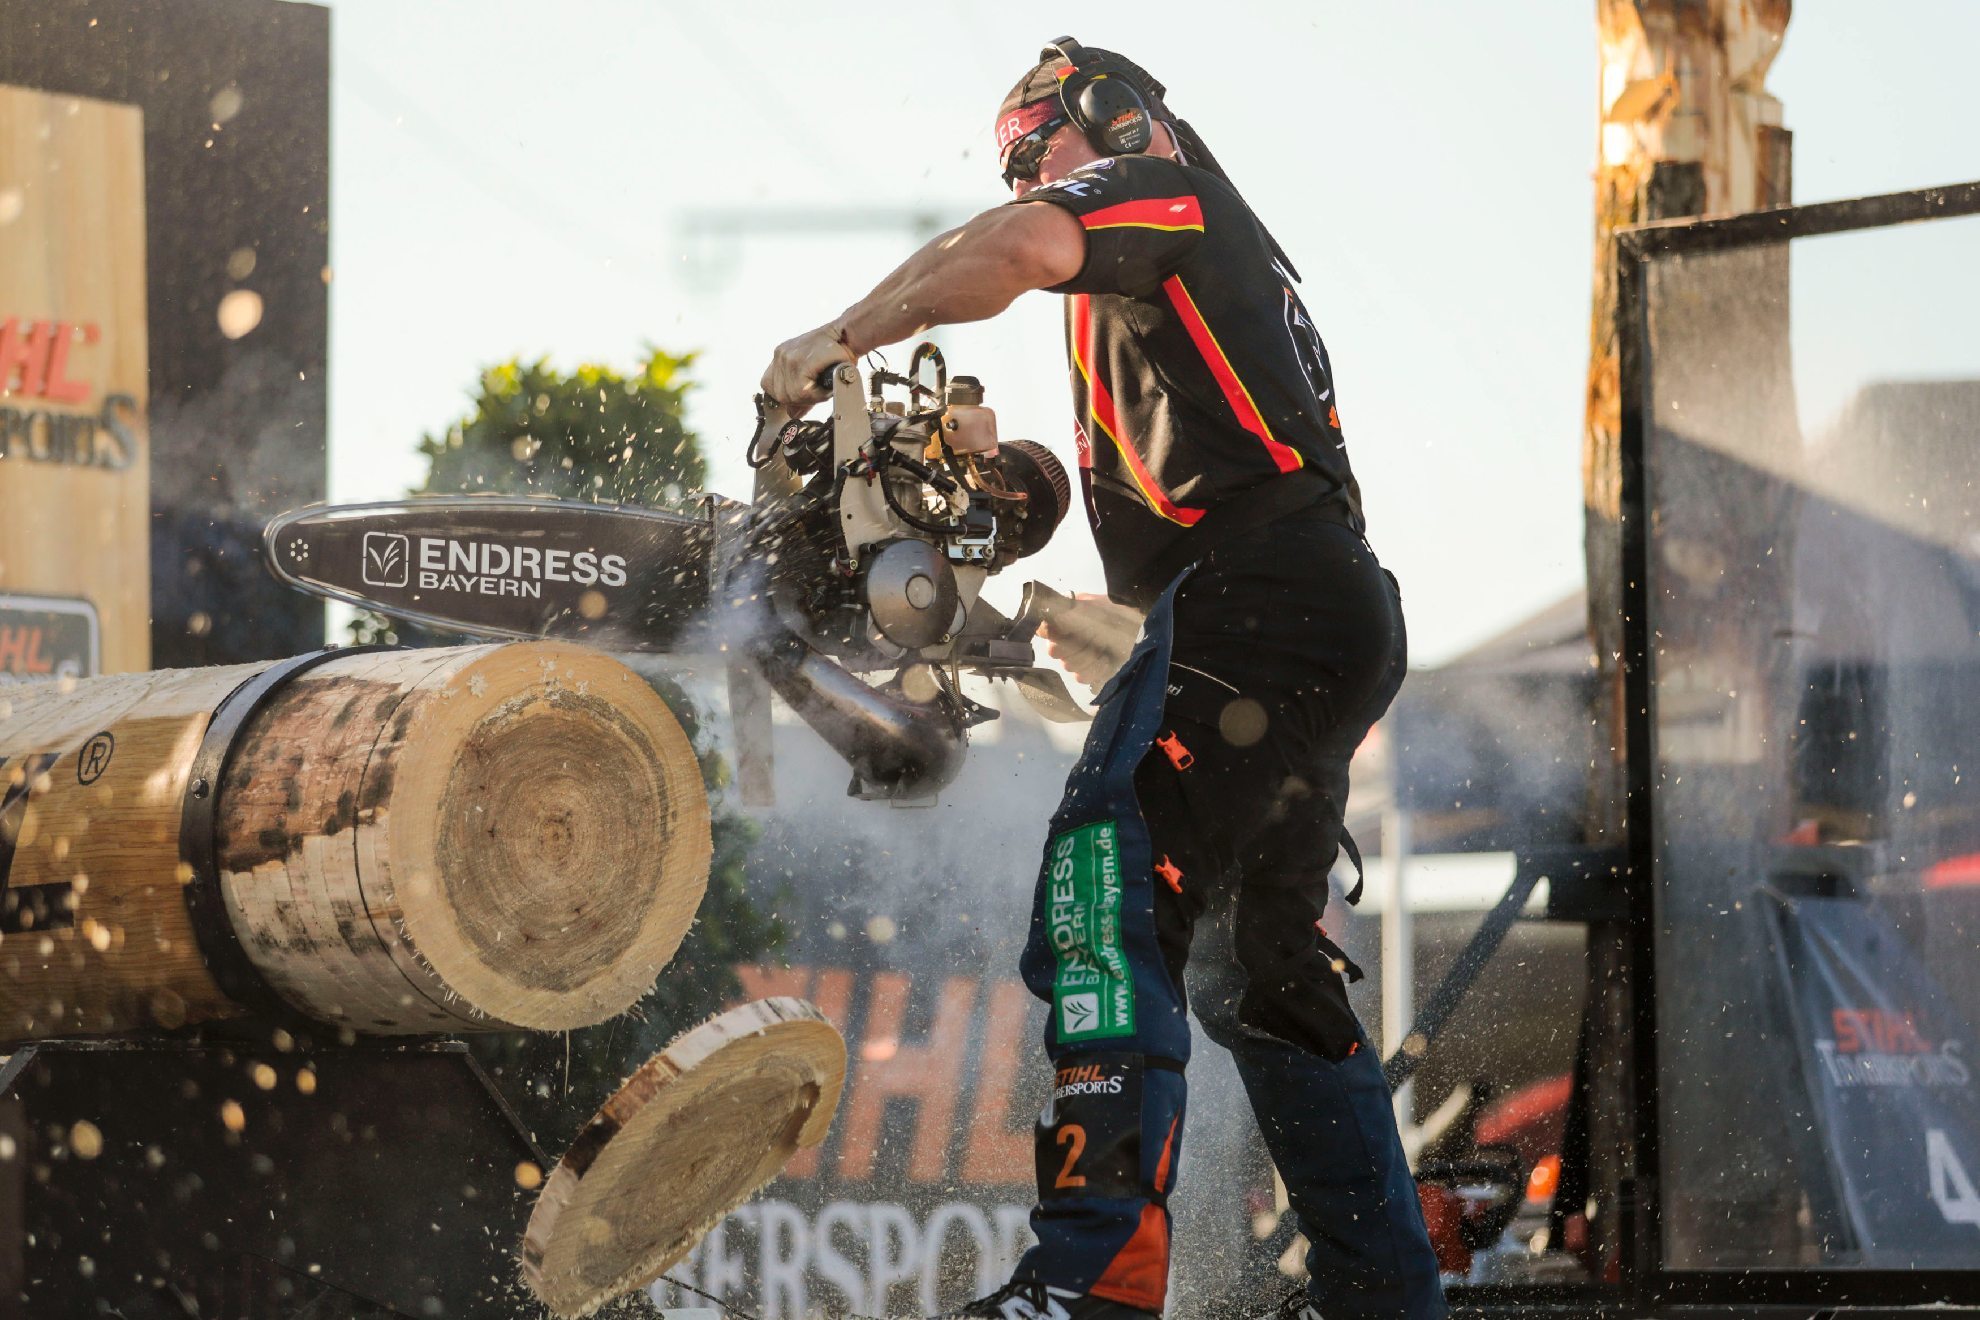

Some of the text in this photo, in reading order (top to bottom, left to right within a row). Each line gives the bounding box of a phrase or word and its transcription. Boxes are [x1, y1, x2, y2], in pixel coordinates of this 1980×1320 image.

[997, 117, 1024, 151] ER
[419, 537, 627, 587] ENDRESS
[419, 570, 541, 598] BAYERN
[1052, 836, 1086, 987] ENDRESS
[1832, 1008, 1932, 1053] STIHL
[1055, 1123, 1087, 1189] 2
[1925, 1128, 1980, 1230] 4
